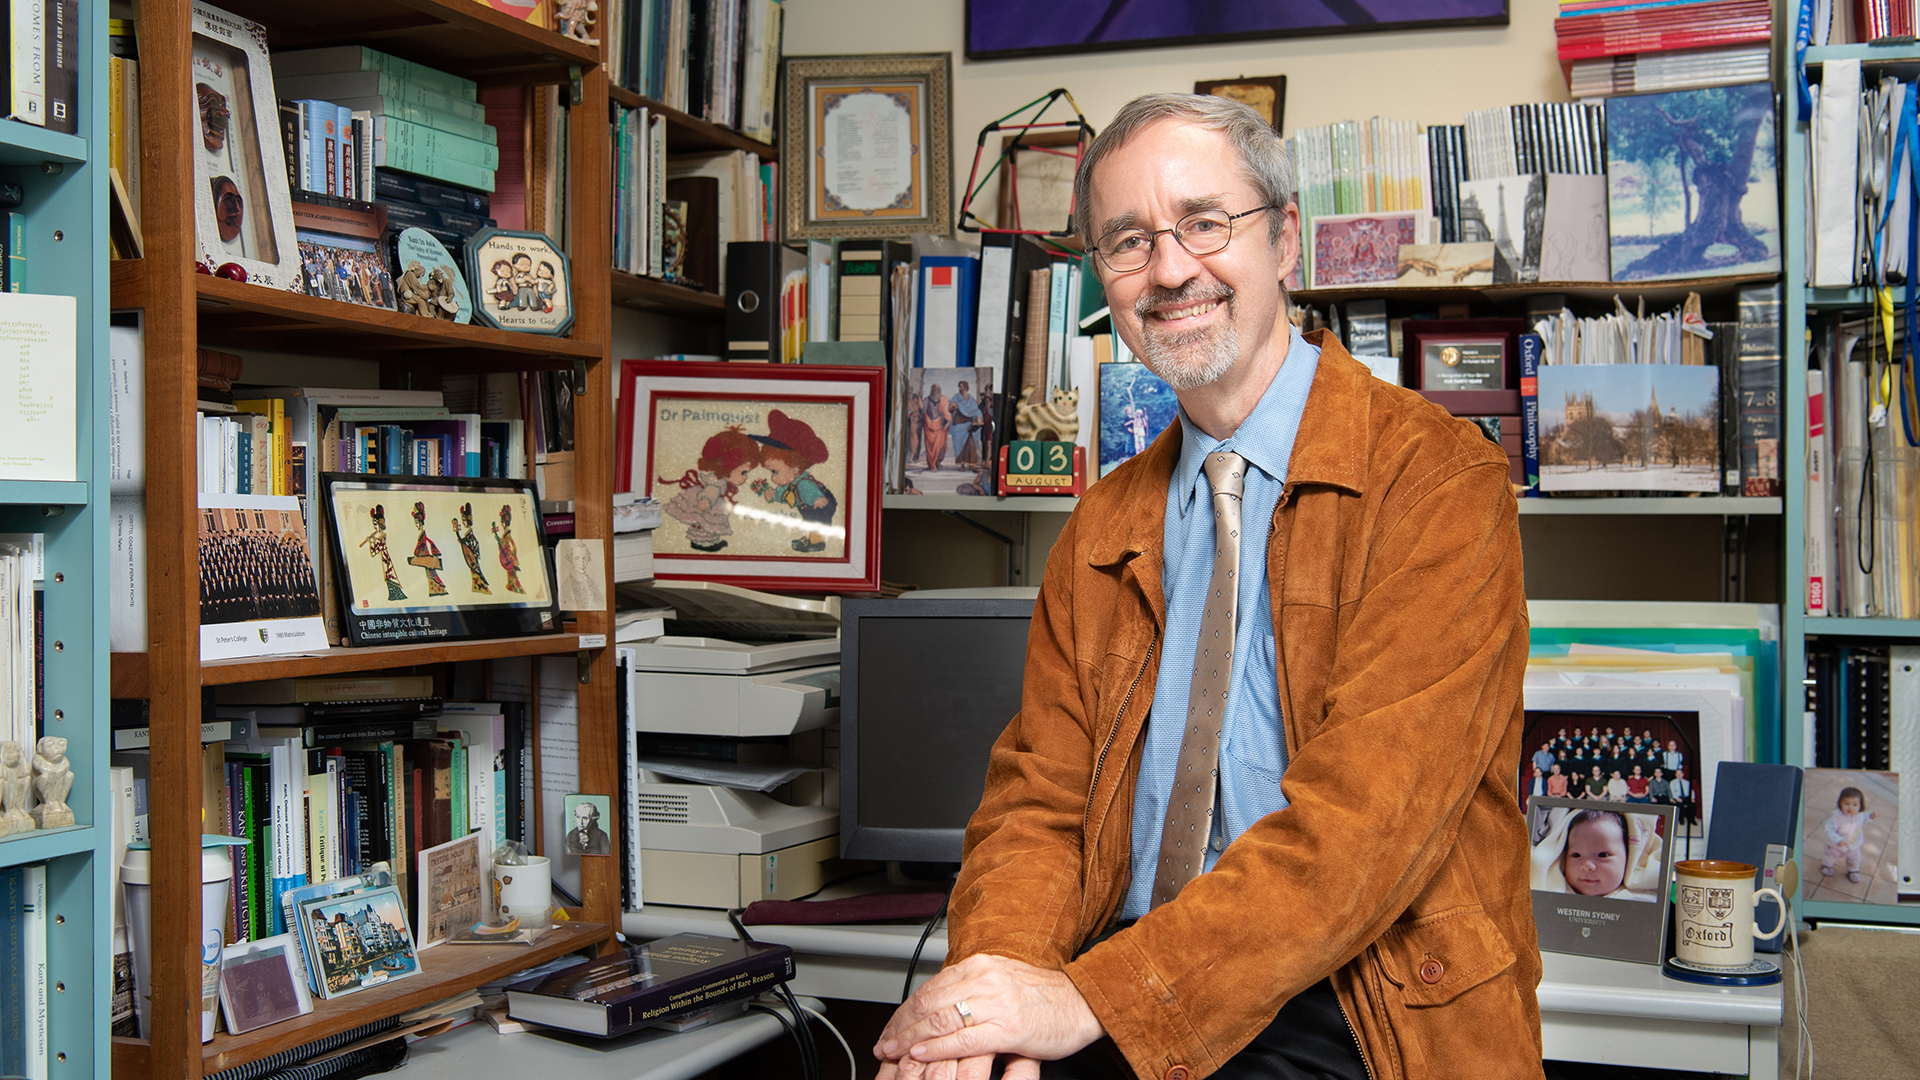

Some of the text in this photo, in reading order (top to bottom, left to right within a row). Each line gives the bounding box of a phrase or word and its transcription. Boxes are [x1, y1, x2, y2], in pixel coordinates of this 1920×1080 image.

[32, 46, 42, 84] FROM
[56, 40, 64, 68] JOHNSON
[488, 241, 514, 251] Hands
[517, 244, 527, 252] to
[499, 315, 527, 325] Hearts
[528, 317, 537, 325] to
[1523, 338, 1537, 460] Oxford Philosophy
[1743, 390, 1777, 407] 7 8
[660, 408, 761, 425] Dr Palmquist
[259, 439, 267, 487] KANT
[1015, 477, 1067, 487] AUGUST
[546, 519, 574, 527] CAMBRIDGE
[1811, 581, 1822, 605] 5160
[360, 630, 382, 640] Chinese
[382, 630, 407, 640] intangible
[427, 628, 448, 638] heritage
[318, 809, 326, 833] Kant's
[319, 835, 327, 863] Critique
[240, 869, 249, 940] SKEPTICISM
[1556, 907, 1621, 921] WESTERN SYDNEY
[1568, 917, 1607, 926] UNIVERSITY
[1685, 927, 1727, 941] Oxford
[642, 1005, 670, 1019] Religion
[670, 999, 692, 1011] Within
[693, 994, 704, 1004] the
[705, 986, 729, 1001] Bounds
[737, 978, 751, 989] Bare
[752, 972, 775, 985] Reason
[668, 986, 702, 1001] Comprehensive
[702, 980, 730, 992] Commentary
[735, 972, 749, 982] Kant's
[36, 963, 45, 1056] Kant and Mysticism
